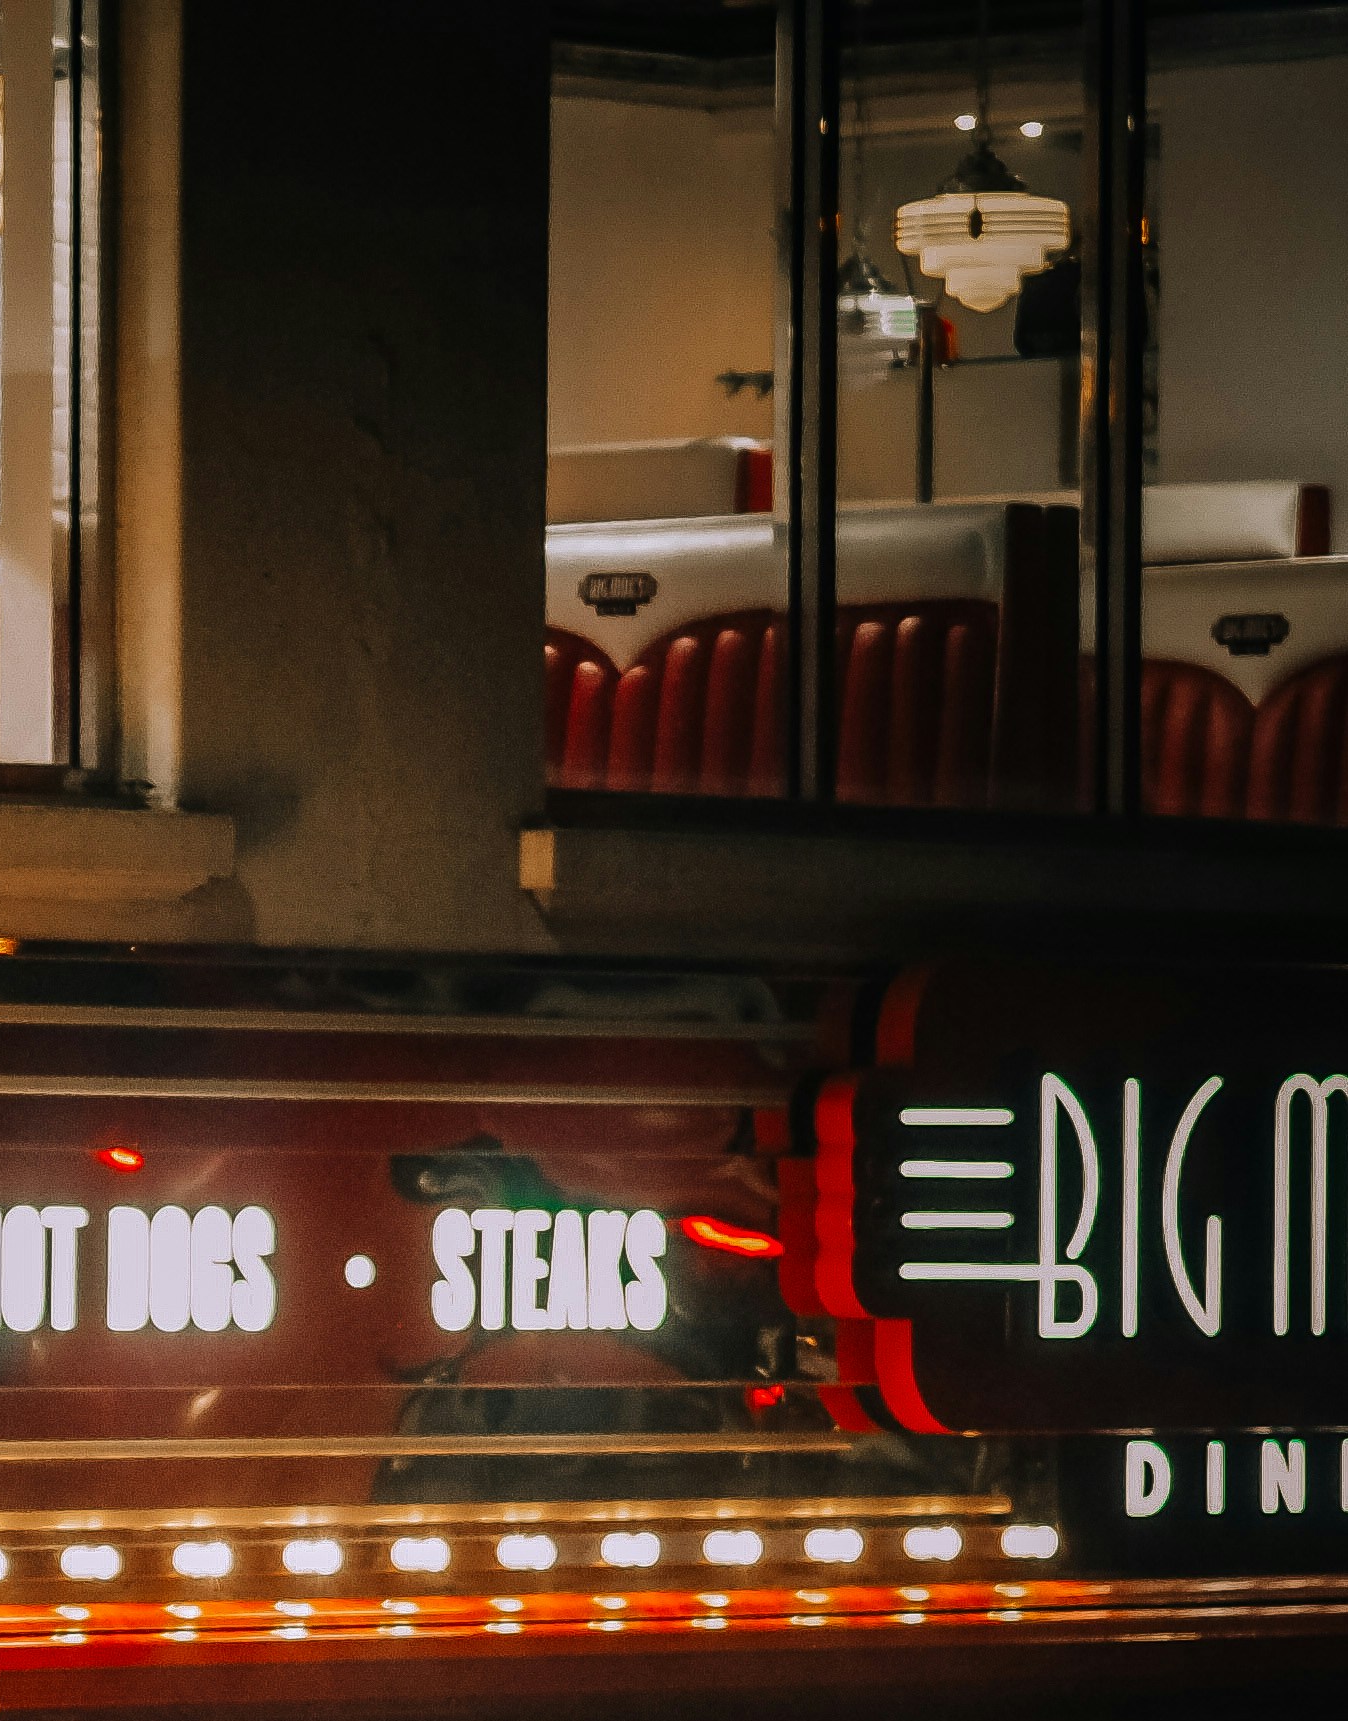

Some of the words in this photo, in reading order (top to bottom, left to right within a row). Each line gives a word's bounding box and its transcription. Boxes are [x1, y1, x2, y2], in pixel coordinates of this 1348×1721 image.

[1039, 1073, 1223, 1338] BIG
[107, 1205, 277, 1332] DOGS
[431, 1208, 667, 1332] STEAKS
[1124, 1438, 1348, 1518] DIN
